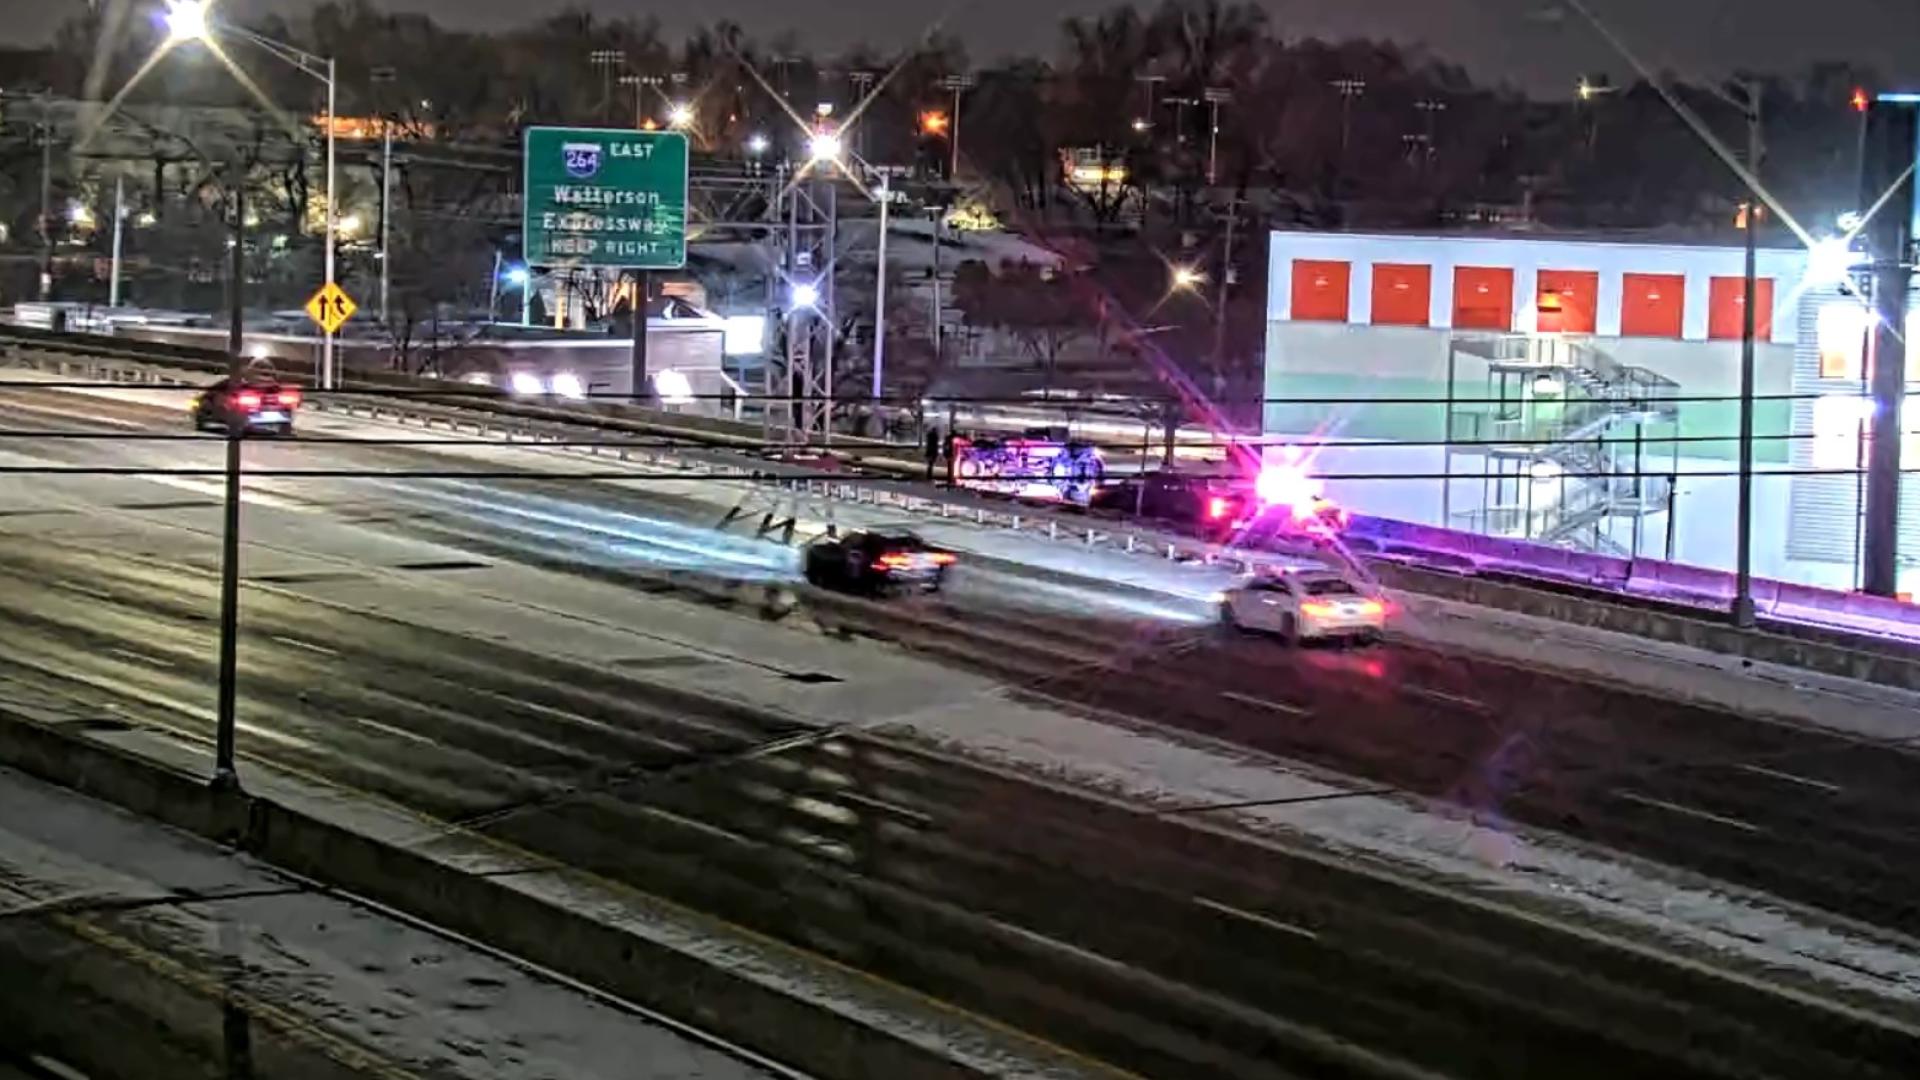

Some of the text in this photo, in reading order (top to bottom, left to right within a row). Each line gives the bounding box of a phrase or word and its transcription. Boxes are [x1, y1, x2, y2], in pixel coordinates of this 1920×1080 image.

[566, 142, 655, 168] 264 EAST
[554, 184, 660, 205] Watterson
[605, 240, 658, 256] RIGHT
